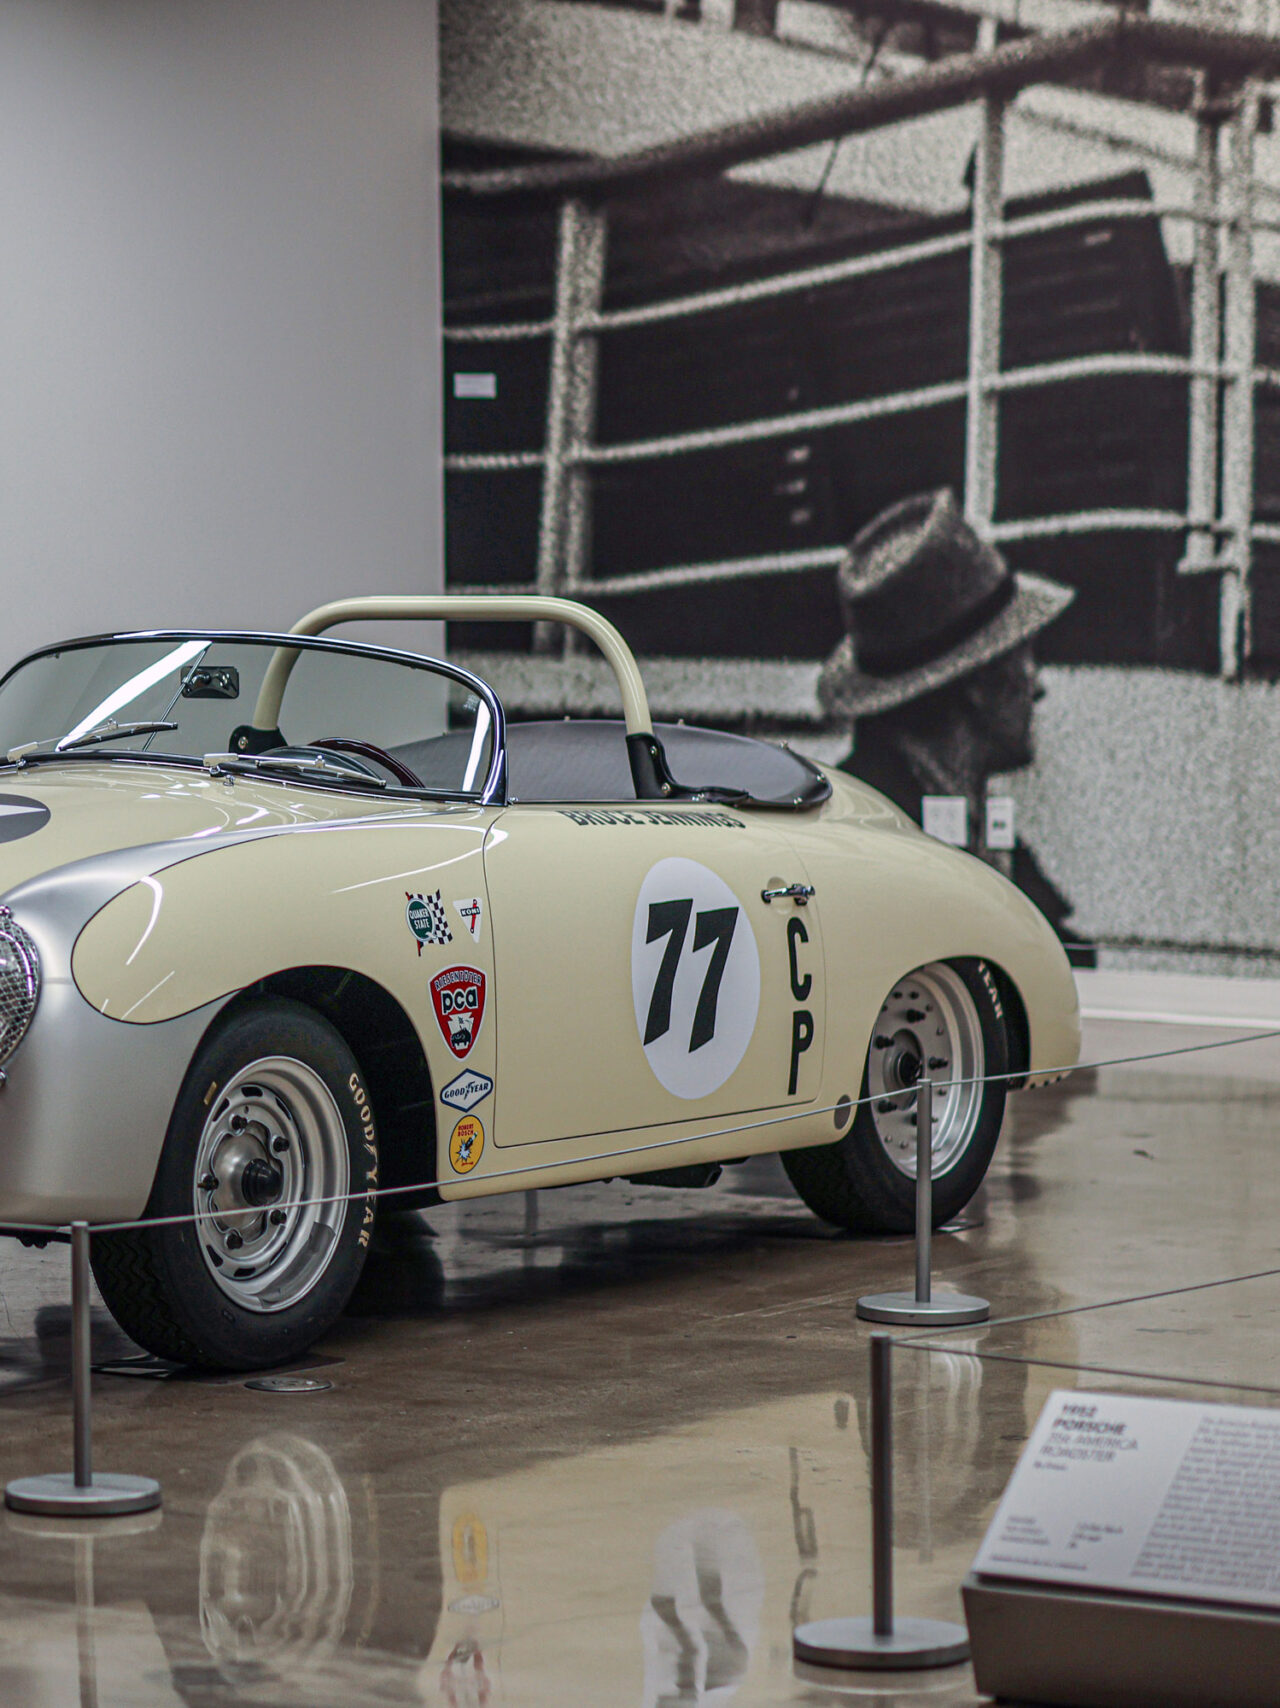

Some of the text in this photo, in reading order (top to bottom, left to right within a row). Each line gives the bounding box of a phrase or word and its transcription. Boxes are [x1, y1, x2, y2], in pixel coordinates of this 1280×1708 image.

[557, 810, 746, 829] BRUCE JENNINGS
[409, 908, 430, 920] QUAKER
[414, 918, 430, 930] STATE
[643, 898, 739, 1053] 77
[440, 986, 479, 1016] pca
[1052, 1418, 1127, 1436] PORSCHE
